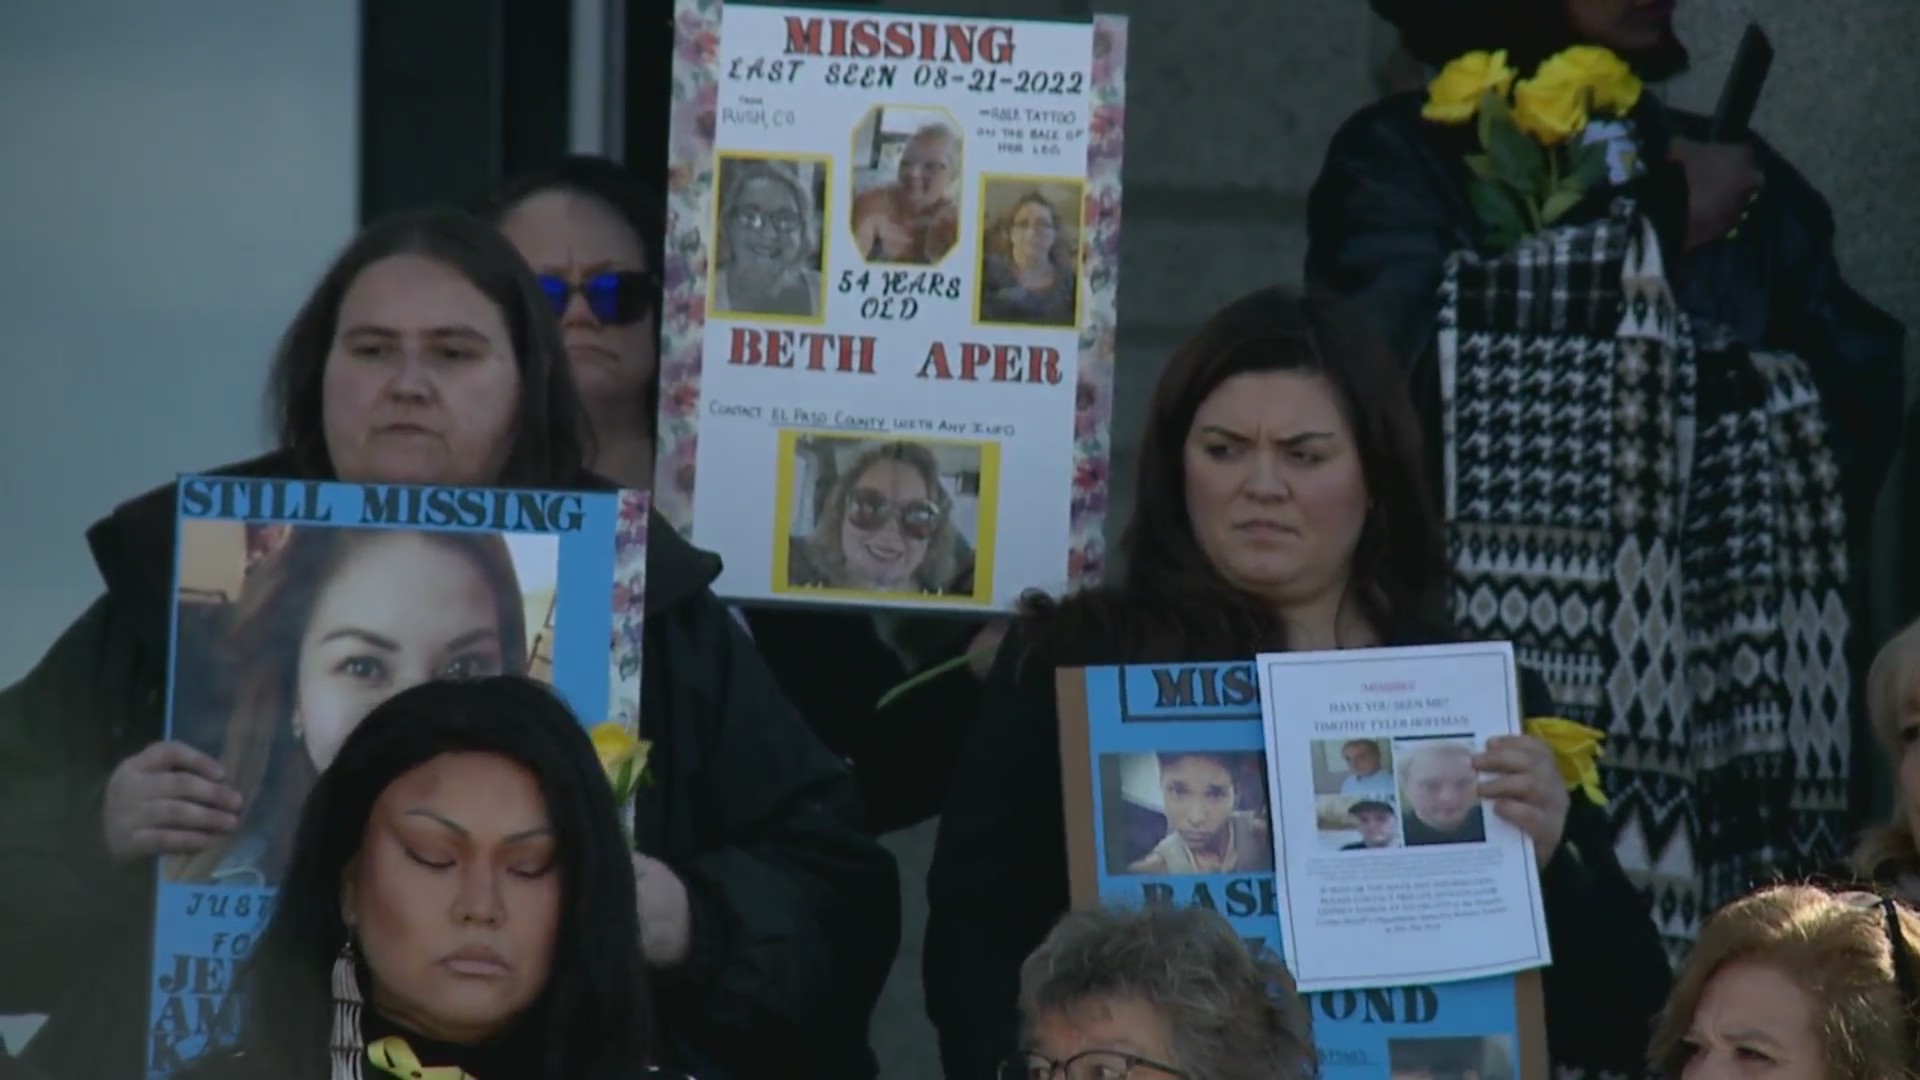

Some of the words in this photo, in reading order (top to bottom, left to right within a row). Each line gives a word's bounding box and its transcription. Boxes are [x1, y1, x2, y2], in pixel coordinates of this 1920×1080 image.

[783, 16, 1016, 64] MISSING
[728, 58, 805, 84] LAST
[825, 62, 897, 89] SEEN
[914, 70, 1084, 95] 08-21-2022
[838, 270, 869, 294] 54
[881, 270, 962, 300] YEARS
[860, 297, 919, 321] OLD
[727, 327, 878, 374] BETH
[916, 341, 1063, 385] APER
[771, 406, 788, 422] EL
[182, 479, 333, 521] STILL
[359, 484, 586, 532] MISSING
[1151, 665, 1259, 708] MIS
[186, 893, 271, 920] JUST
[212, 933, 252, 955] FO
[1299, 985, 1438, 1024] OND
